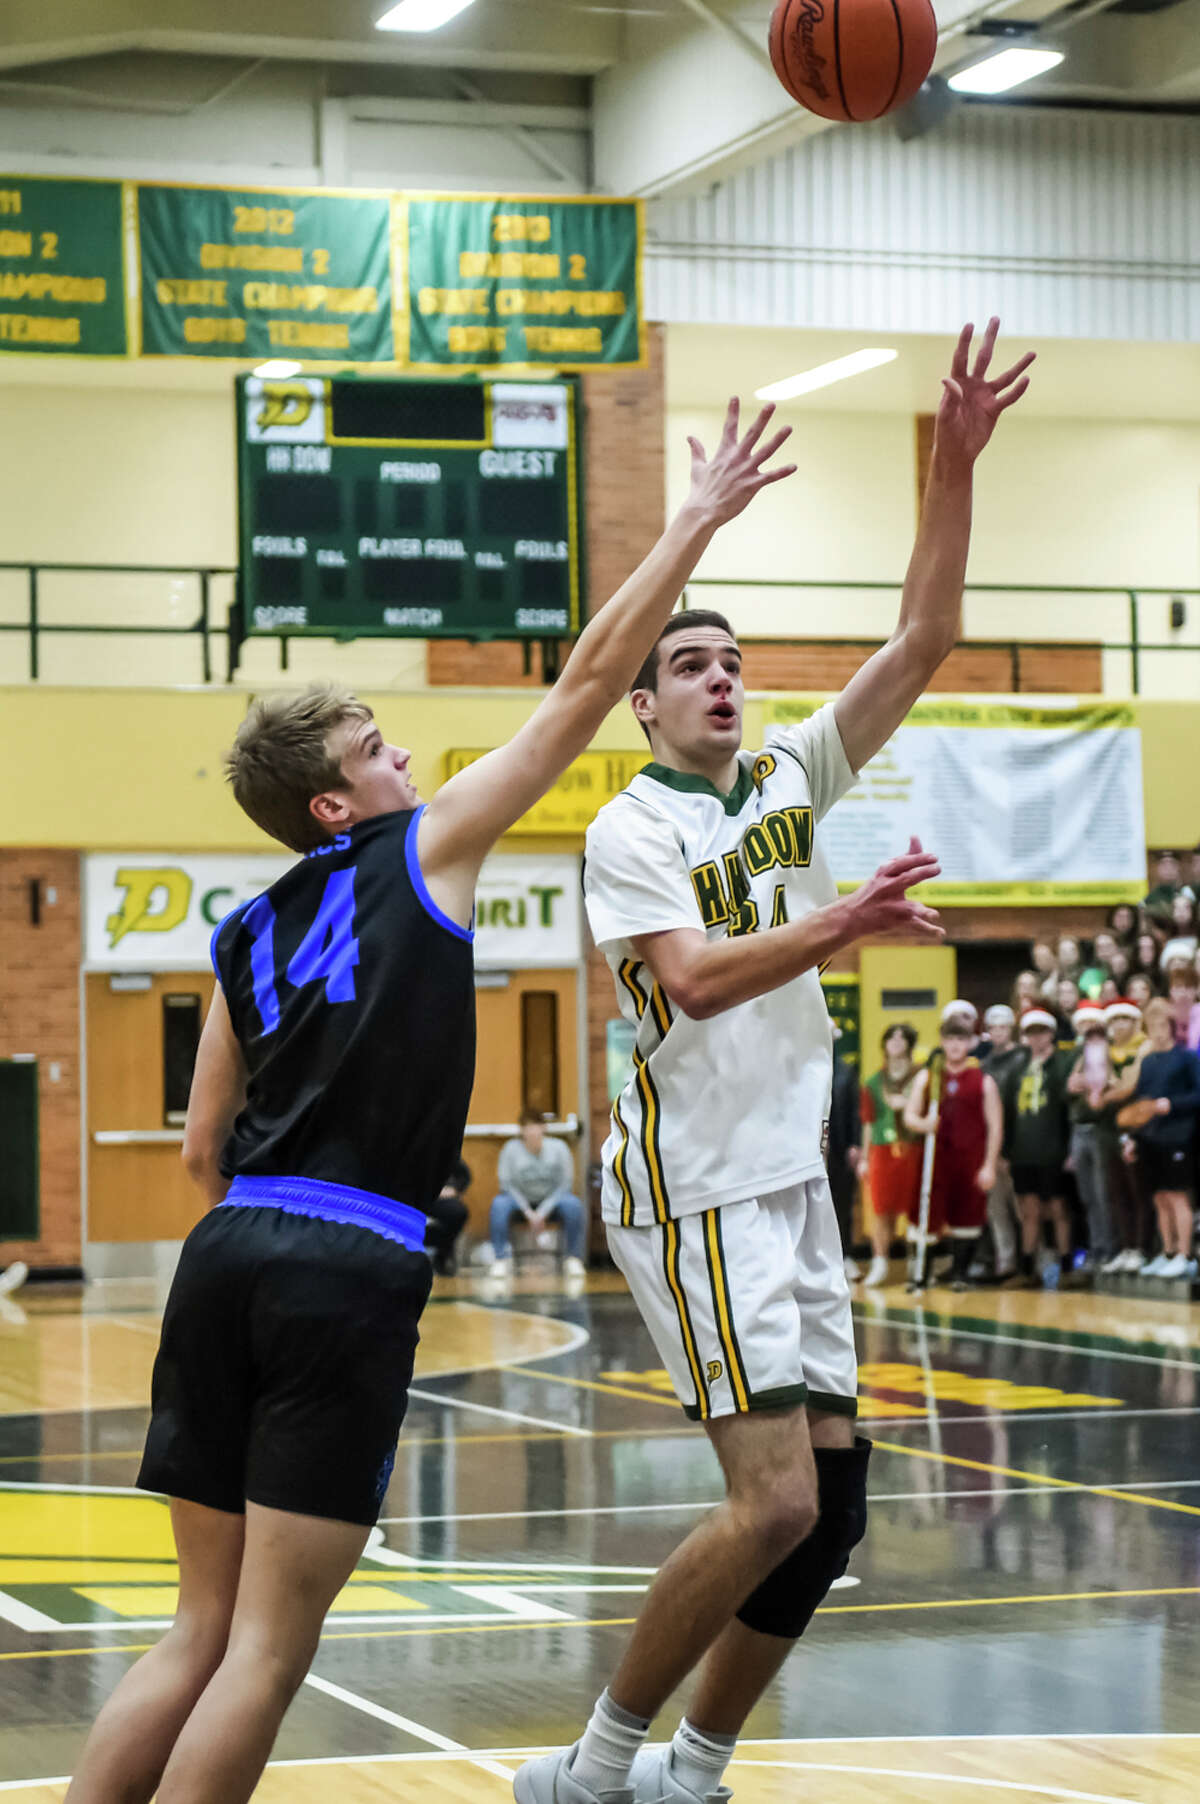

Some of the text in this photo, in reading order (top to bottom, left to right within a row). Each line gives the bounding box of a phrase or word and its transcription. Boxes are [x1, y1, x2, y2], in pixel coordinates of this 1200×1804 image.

[233, 206, 295, 235] 2012
[40, 232, 58, 259] 2
[312, 248, 330, 275] 2
[567, 254, 587, 280] 2
[157, 279, 378, 312] STATE CHAMPIONS
[417, 287, 626, 316] STATE CHAMPIONS
[379, 462, 441, 483] PERIOD
[478, 449, 558, 478] GUEST
[251, 536, 308, 557] FOULS
[358, 537, 423, 558] PLAYER
[514, 540, 569, 560] FOULS
[253, 606, 308, 630] SCORE
[384, 608, 443, 627] MATCH
[515, 608, 569, 628] SCORE
[742, 806, 815, 878] DOW
[241, 866, 361, 1037] 14
